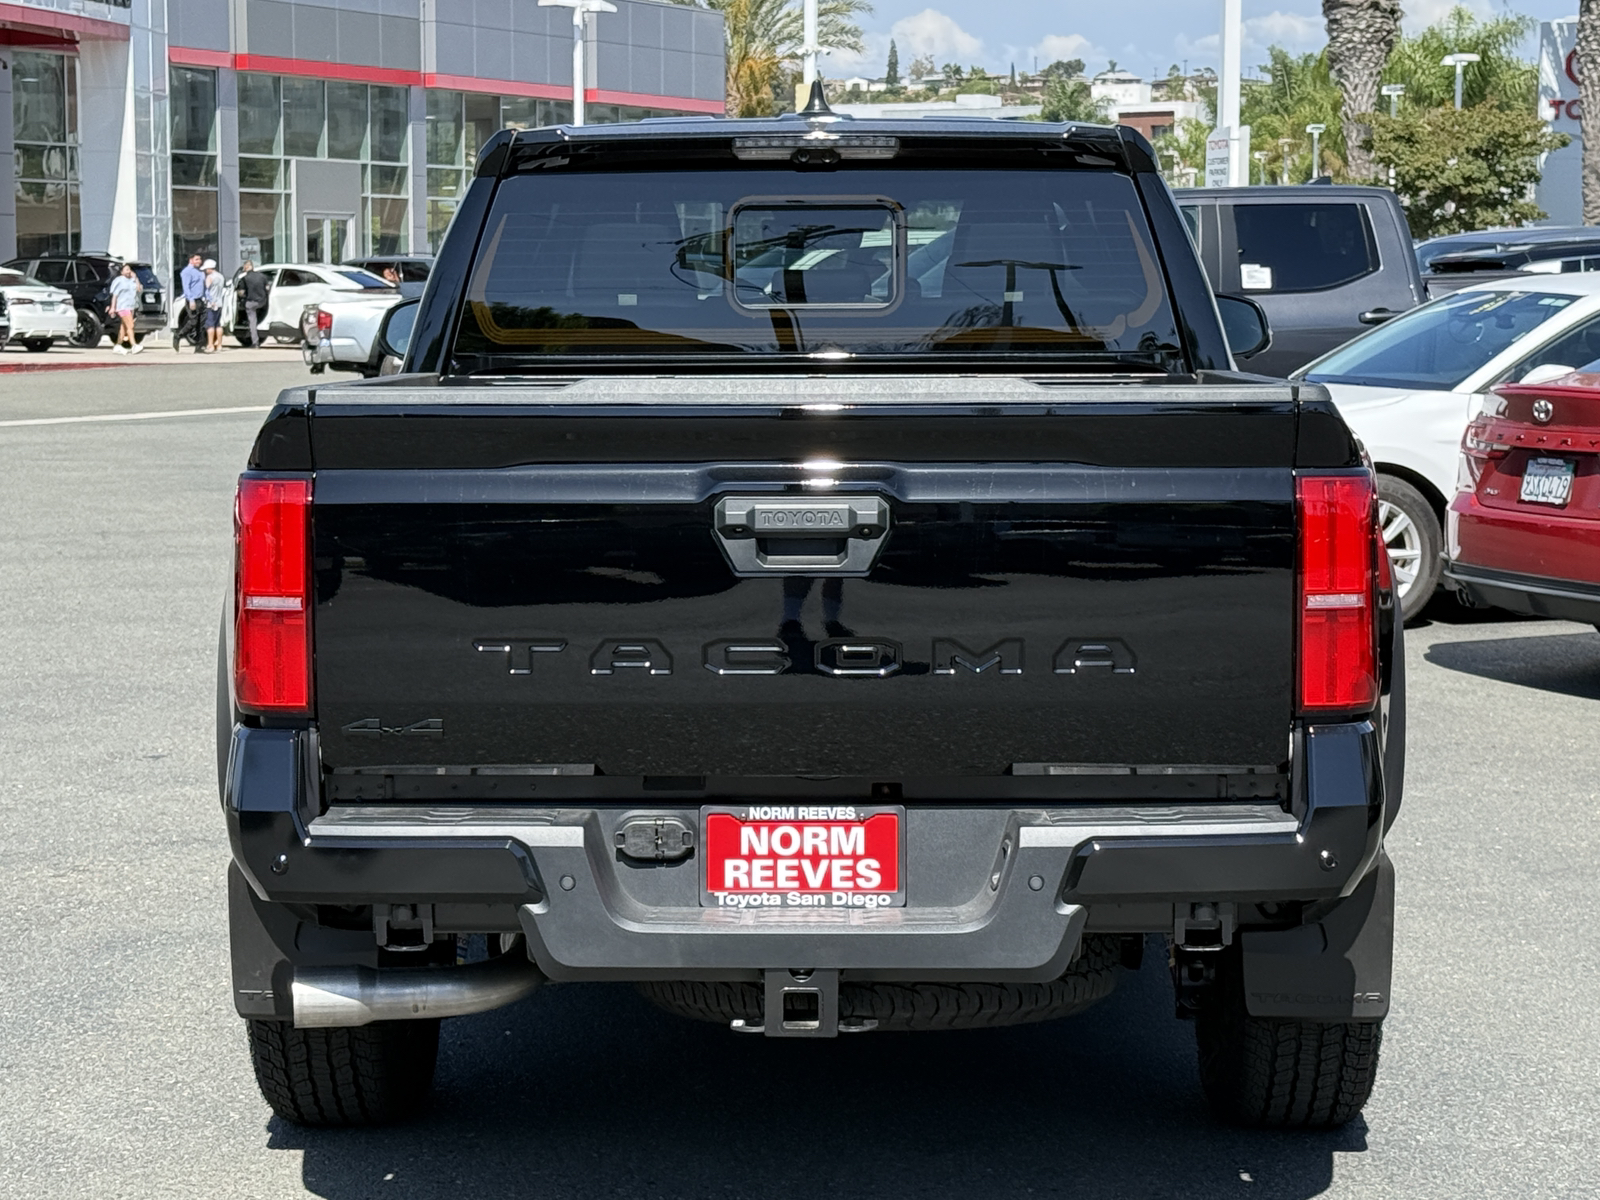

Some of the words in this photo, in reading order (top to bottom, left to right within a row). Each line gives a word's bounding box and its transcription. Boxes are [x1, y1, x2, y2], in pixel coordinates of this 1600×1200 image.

[1209, 167, 1227, 176] PARKING
[760, 510, 844, 527] TOYOTA
[471, 637, 1138, 676] TACOMA
[749, 807, 795, 820] NORM
[798, 807, 856, 820] REEVES
[740, 826, 866, 857] NORM
[723, 858, 882, 889] REEVES
[714, 891, 782, 908] Toyota
[786, 891, 826, 906] San
[831, 891, 891, 908] Diego
